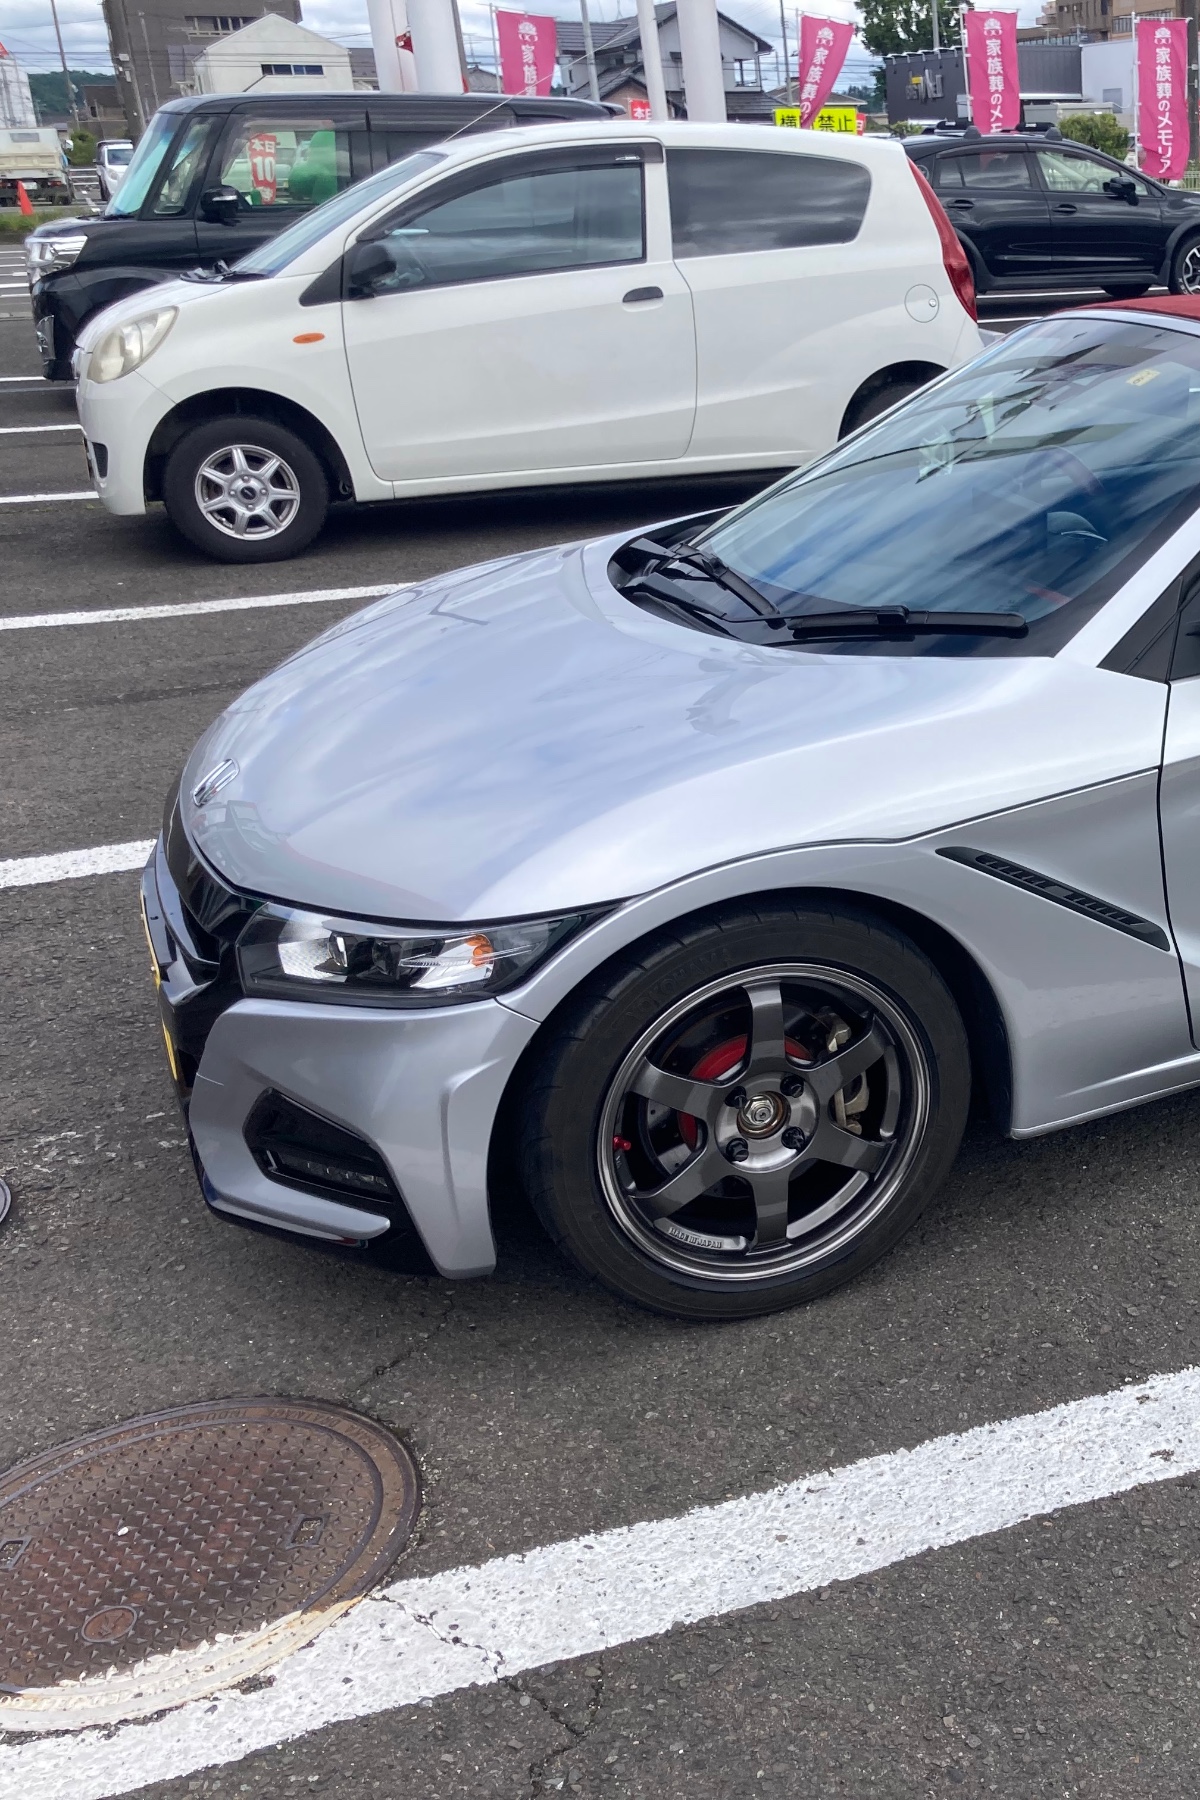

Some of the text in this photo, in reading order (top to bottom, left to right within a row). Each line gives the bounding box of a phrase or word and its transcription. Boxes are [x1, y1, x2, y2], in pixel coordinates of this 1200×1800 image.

[1155, 46, 1174, 174] 家族葬のメモリア
[252, 155, 276, 183] 10
